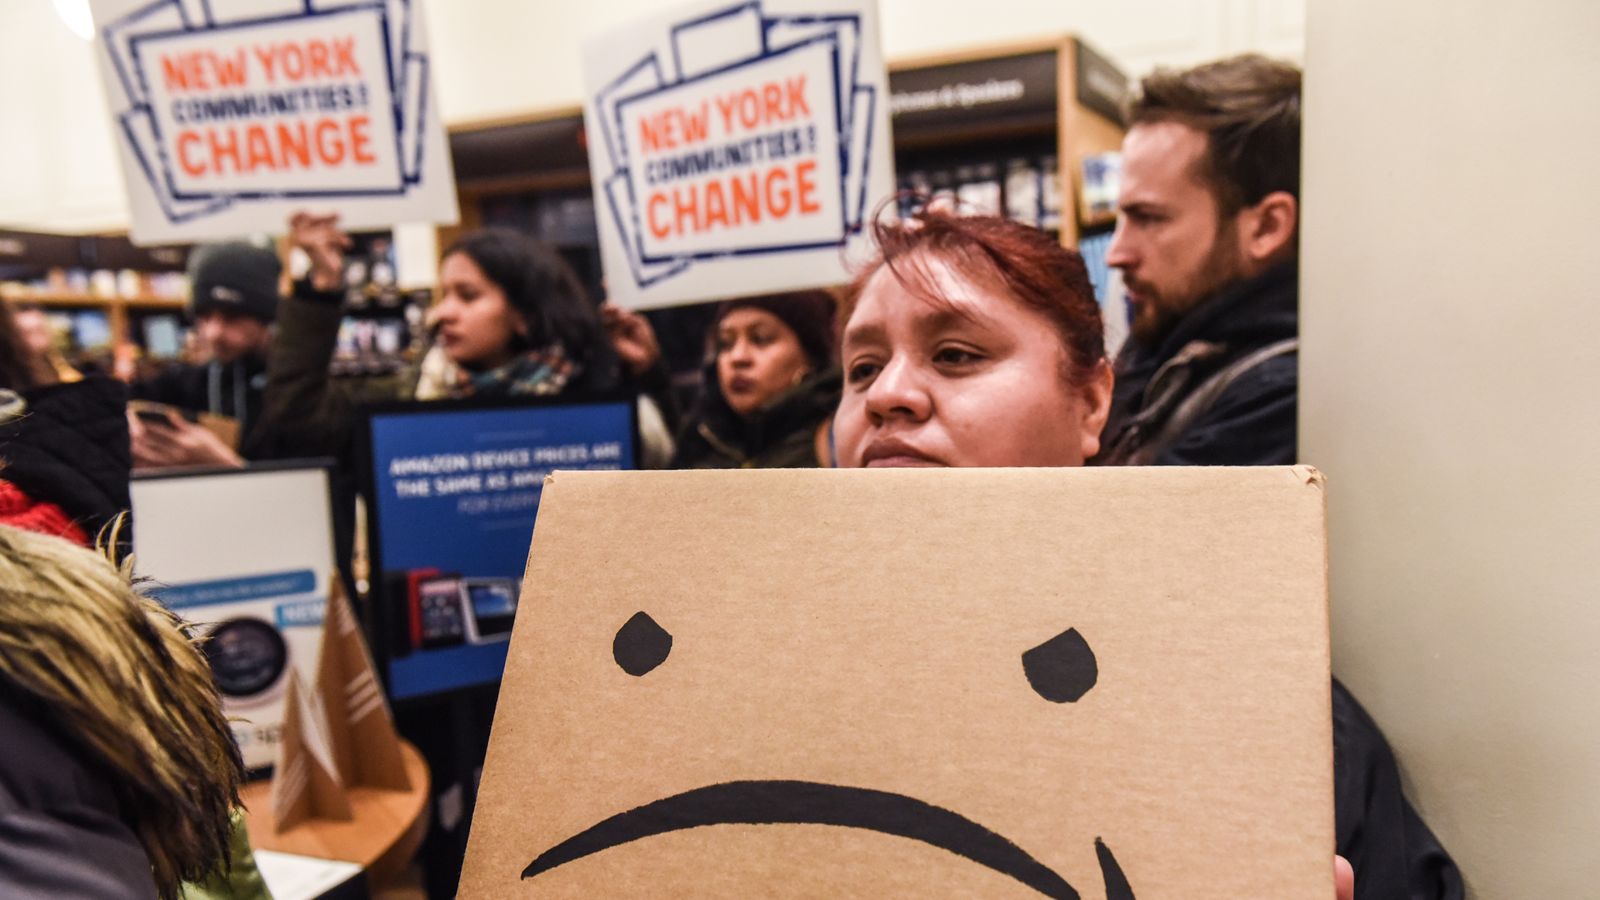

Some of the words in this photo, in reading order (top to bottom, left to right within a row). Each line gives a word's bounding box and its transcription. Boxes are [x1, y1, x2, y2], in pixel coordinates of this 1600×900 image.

[161, 51, 246, 91] NEW
[256, 39, 359, 82] YORK
[639, 103, 708, 151] NEW
[717, 76, 810, 133] YORK
[177, 116, 376, 176] CHANGE
[648, 160, 821, 239] CHANGE
[390, 453, 469, 477] AMAZON
[472, 449, 530, 470] DEVICE
[534, 445, 589, 463] PRICES
[592, 443, 621, 459] ARE
[395, 478, 430, 498] THE
[434, 473, 482, 496] SAME
[486, 471, 508, 490] AS
